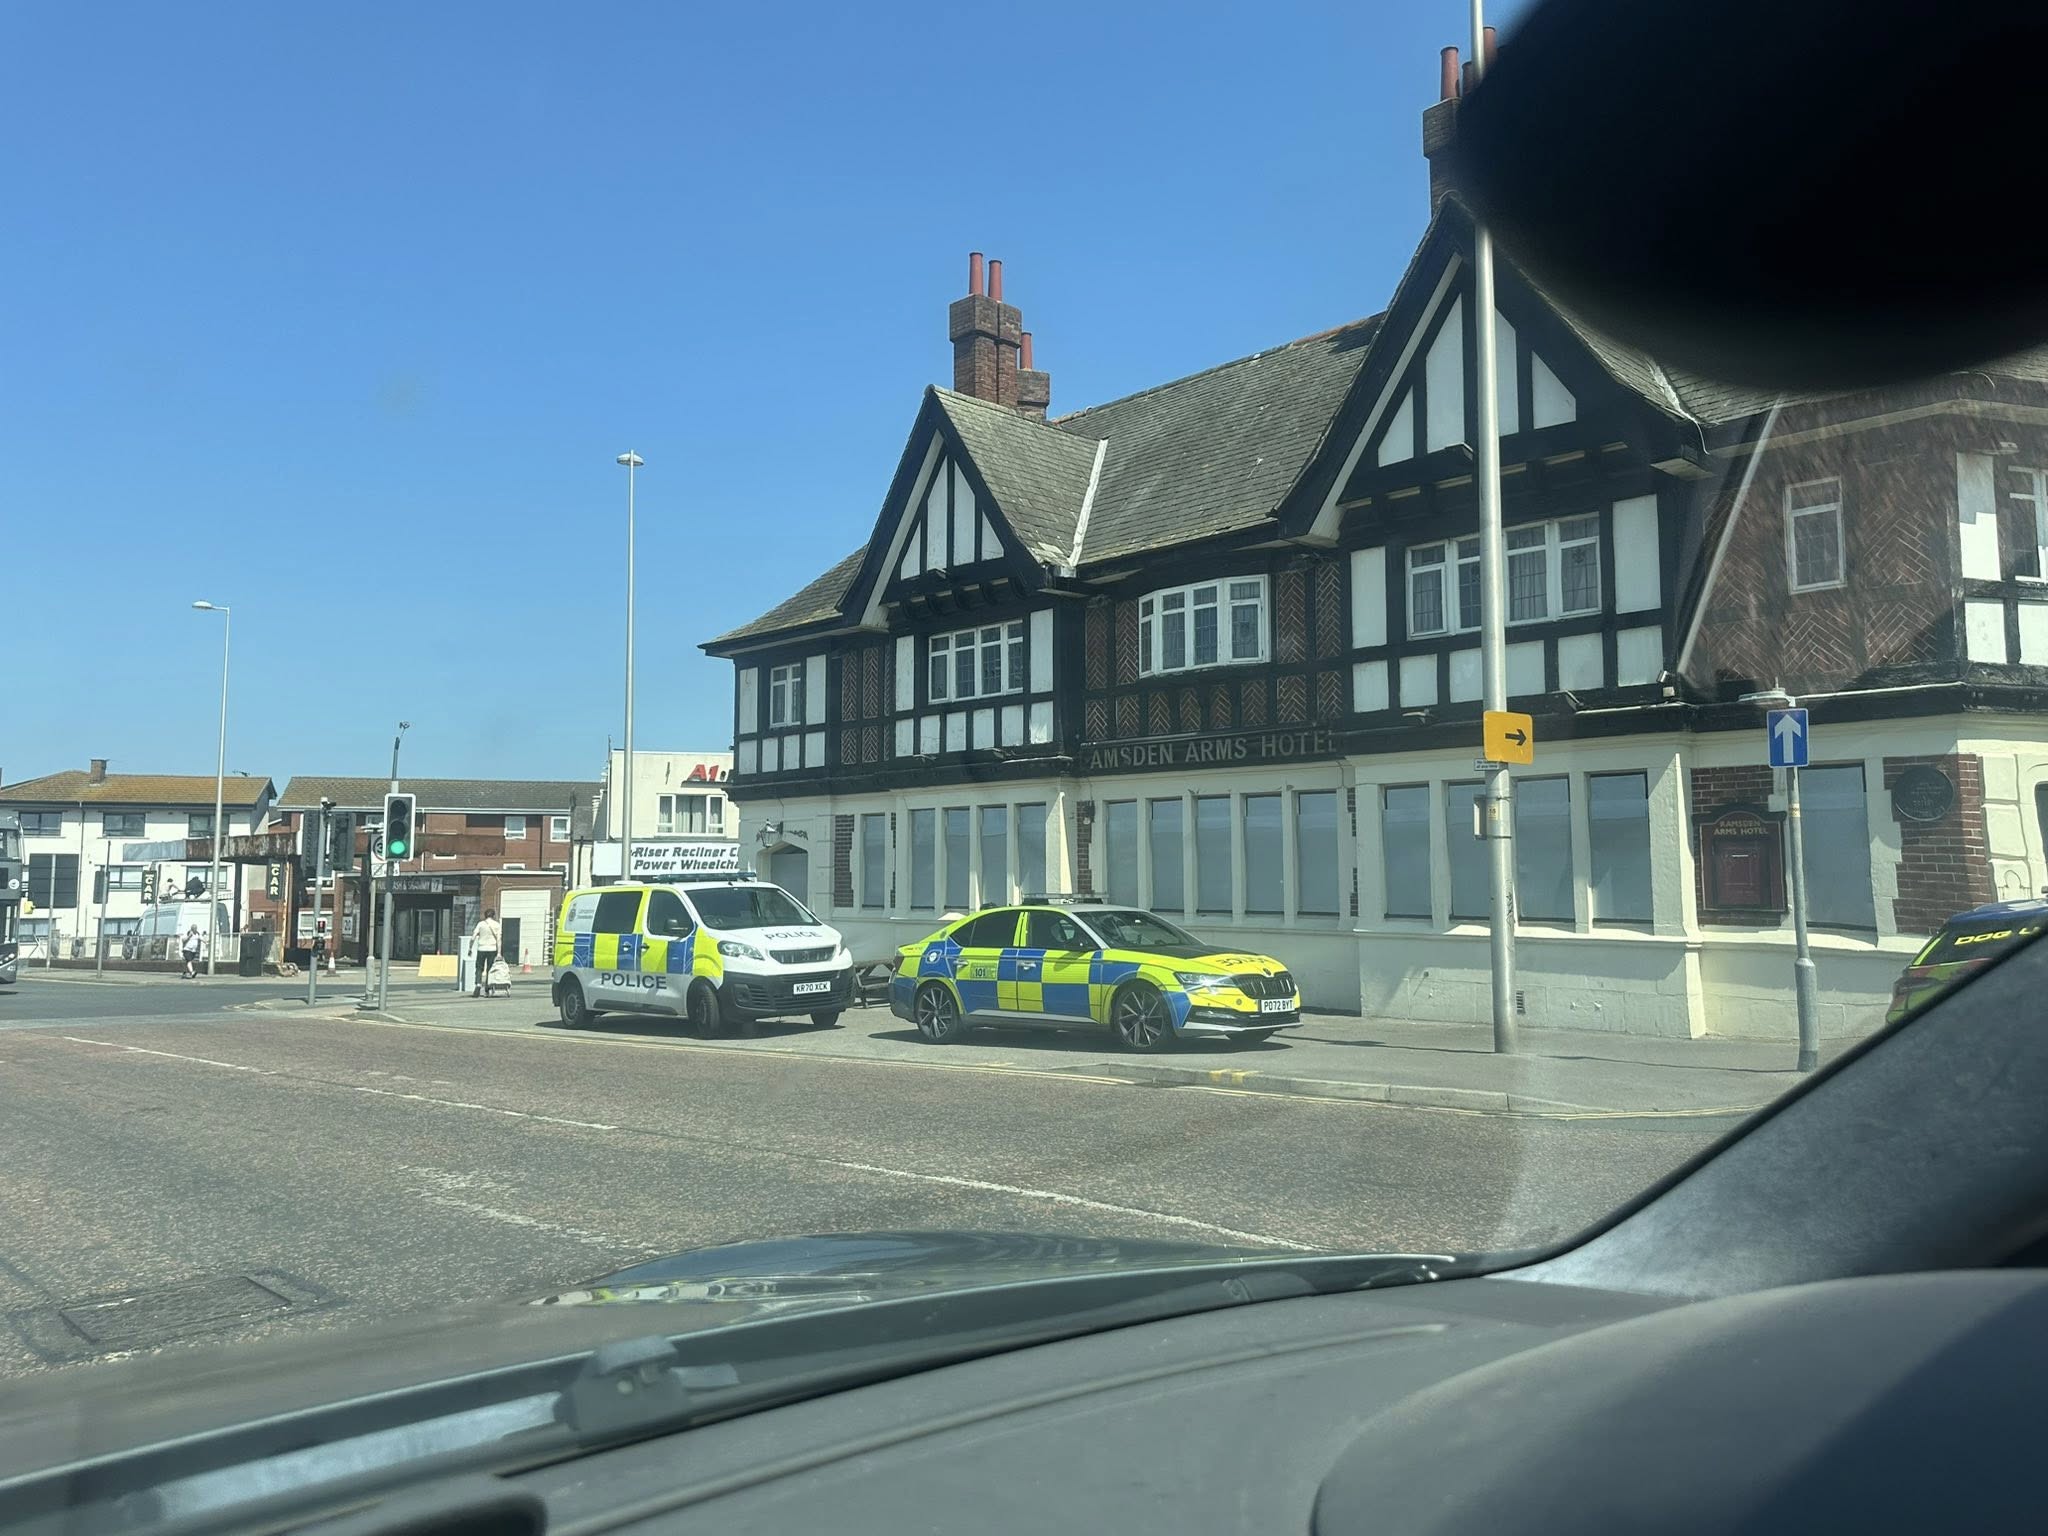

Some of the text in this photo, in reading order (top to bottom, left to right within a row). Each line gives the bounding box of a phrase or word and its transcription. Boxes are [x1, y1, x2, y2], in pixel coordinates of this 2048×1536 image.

[1185, 737, 1247, 762] ARMS
[1261, 730, 1337, 757] HOTEL
[1720, 820, 1761, 828] RAMSDEN
[1713, 827, 1769, 836] ARMS HOTEL
[634, 847, 669, 857] Riser
[672, 847, 726, 857] Recliner
[634, 859, 676, 870] Power
[270, 867, 280, 896] CAR
[764, 931, 823, 940] POLICE
[1954, 930, 2013, 946] DOG
[974, 968, 986, 977] 101
[600, 972, 668, 990] POLICE
[796, 983, 814, 993] KR70
